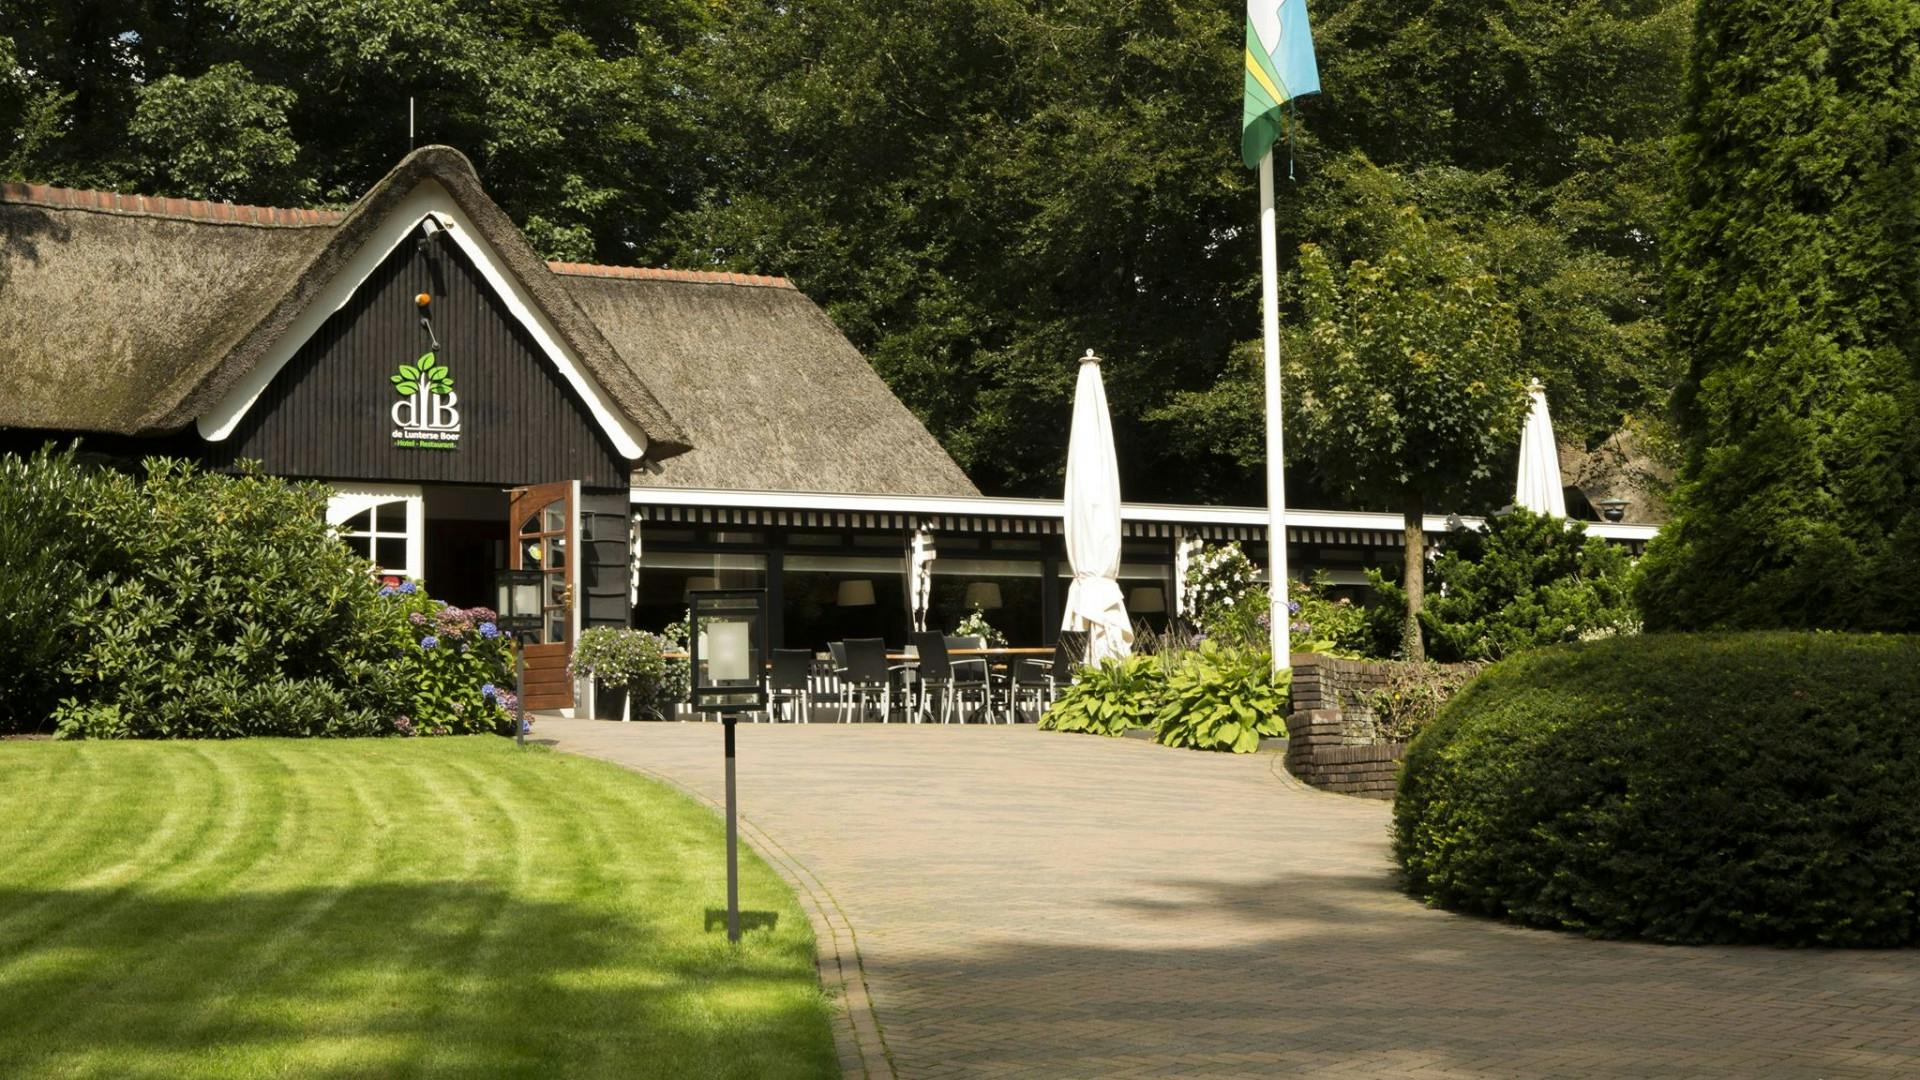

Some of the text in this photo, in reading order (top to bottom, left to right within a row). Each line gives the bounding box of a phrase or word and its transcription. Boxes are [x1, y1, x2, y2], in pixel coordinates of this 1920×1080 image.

[392, 430, 460, 440] de Lunterse Boer
